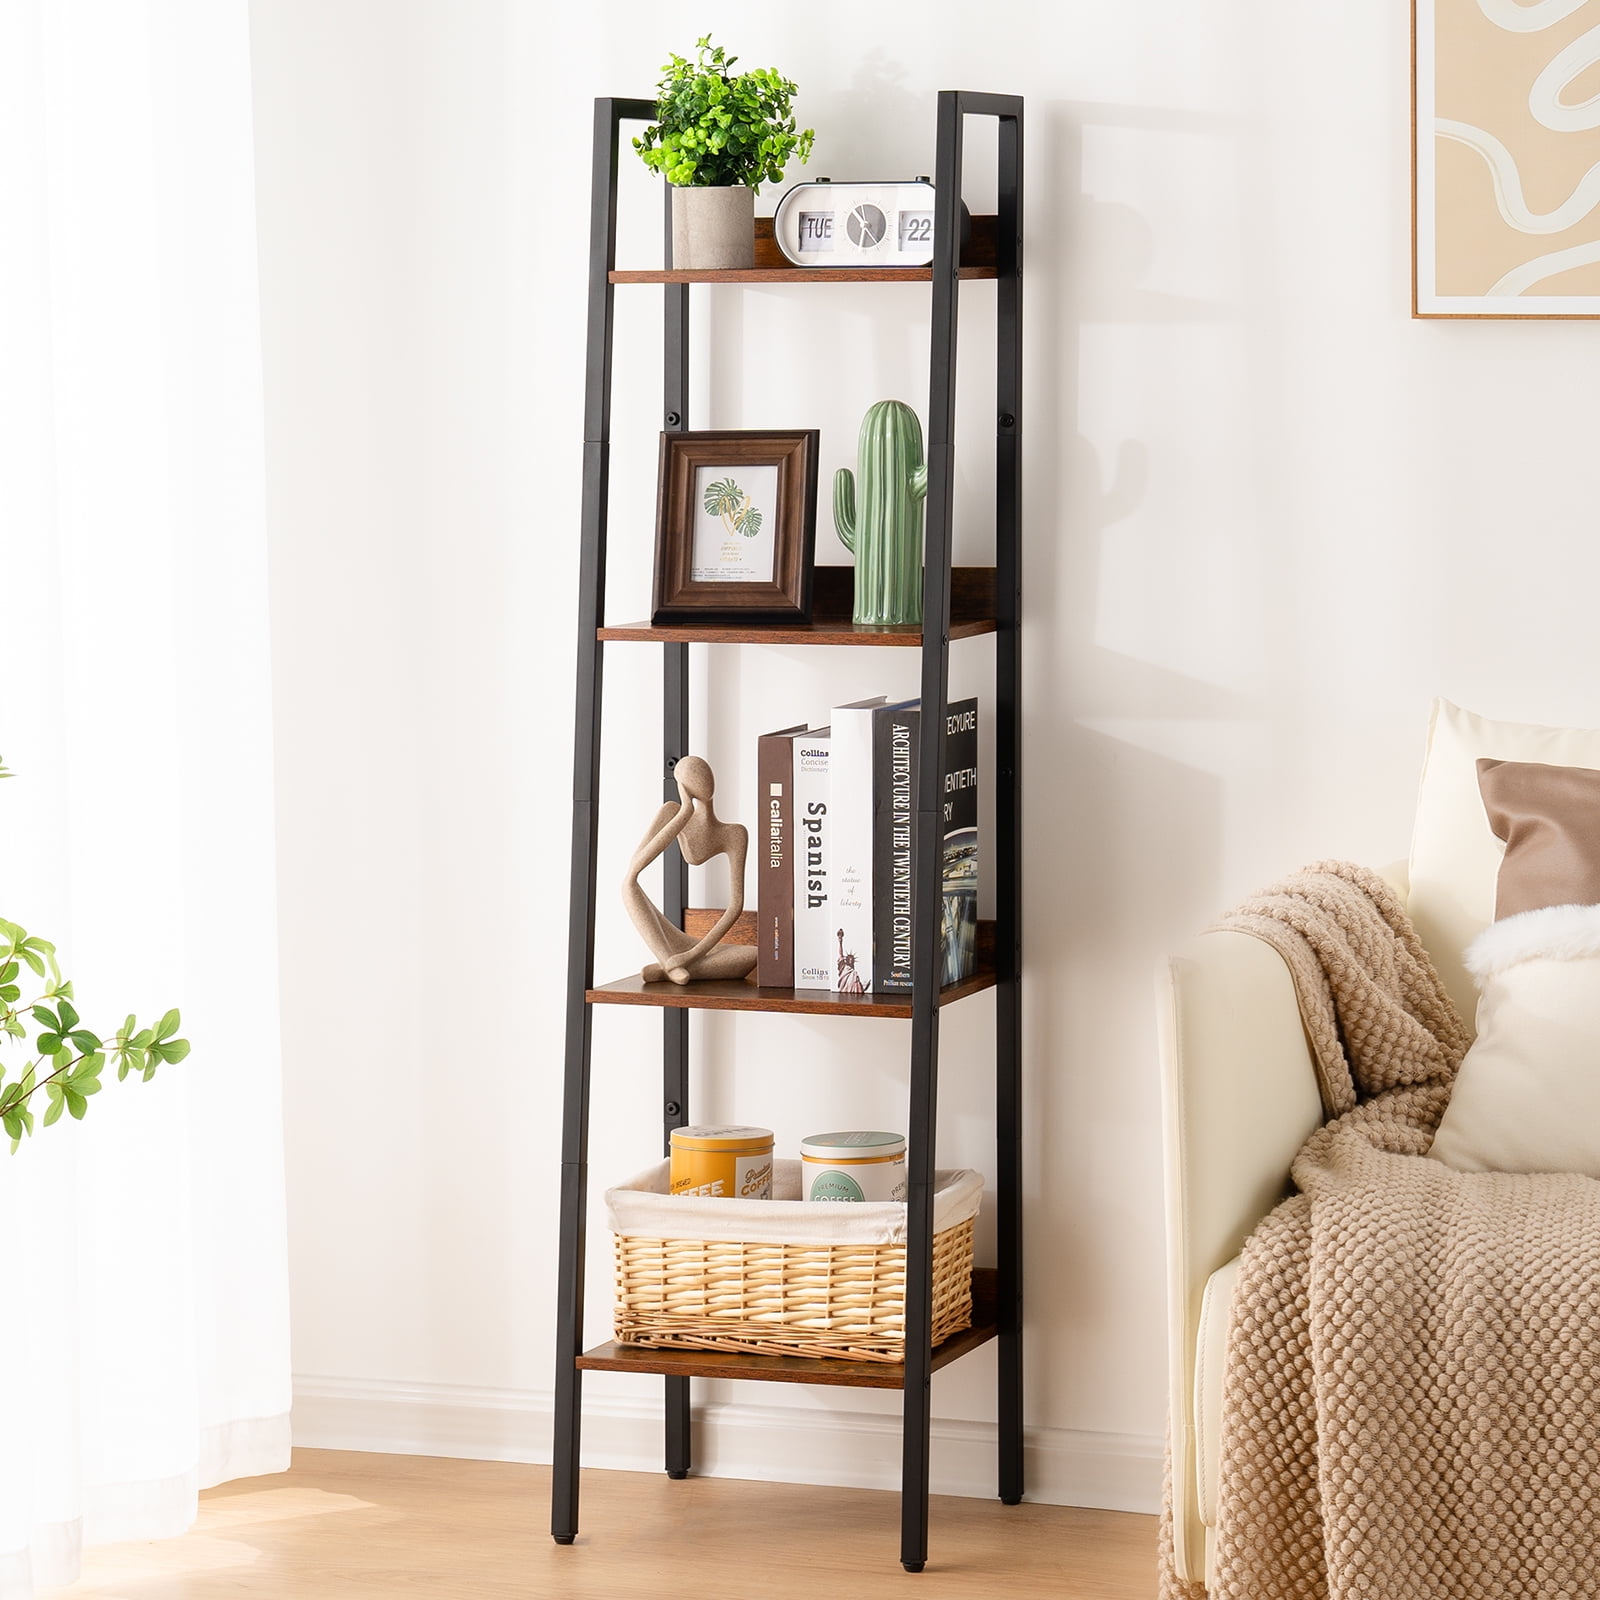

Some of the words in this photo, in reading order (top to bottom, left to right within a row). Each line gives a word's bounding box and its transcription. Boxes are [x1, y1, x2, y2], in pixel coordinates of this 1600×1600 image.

[808, 218, 833, 239] TUE
[907, 218, 931, 241] 22
[800, 749, 829, 757] Collins
[800, 758, 829, 766] Concise
[893, 724, 910, 810] ARCHITECYURE
[893, 811, 910, 824] IN
[893, 826, 910, 848] THE
[802, 802, 828, 909] Spanish
[893, 850, 911, 915] TWENTIETH
[893, 917, 911, 969] CENTURY
[817, 1183, 849, 1194] PREMIUM
